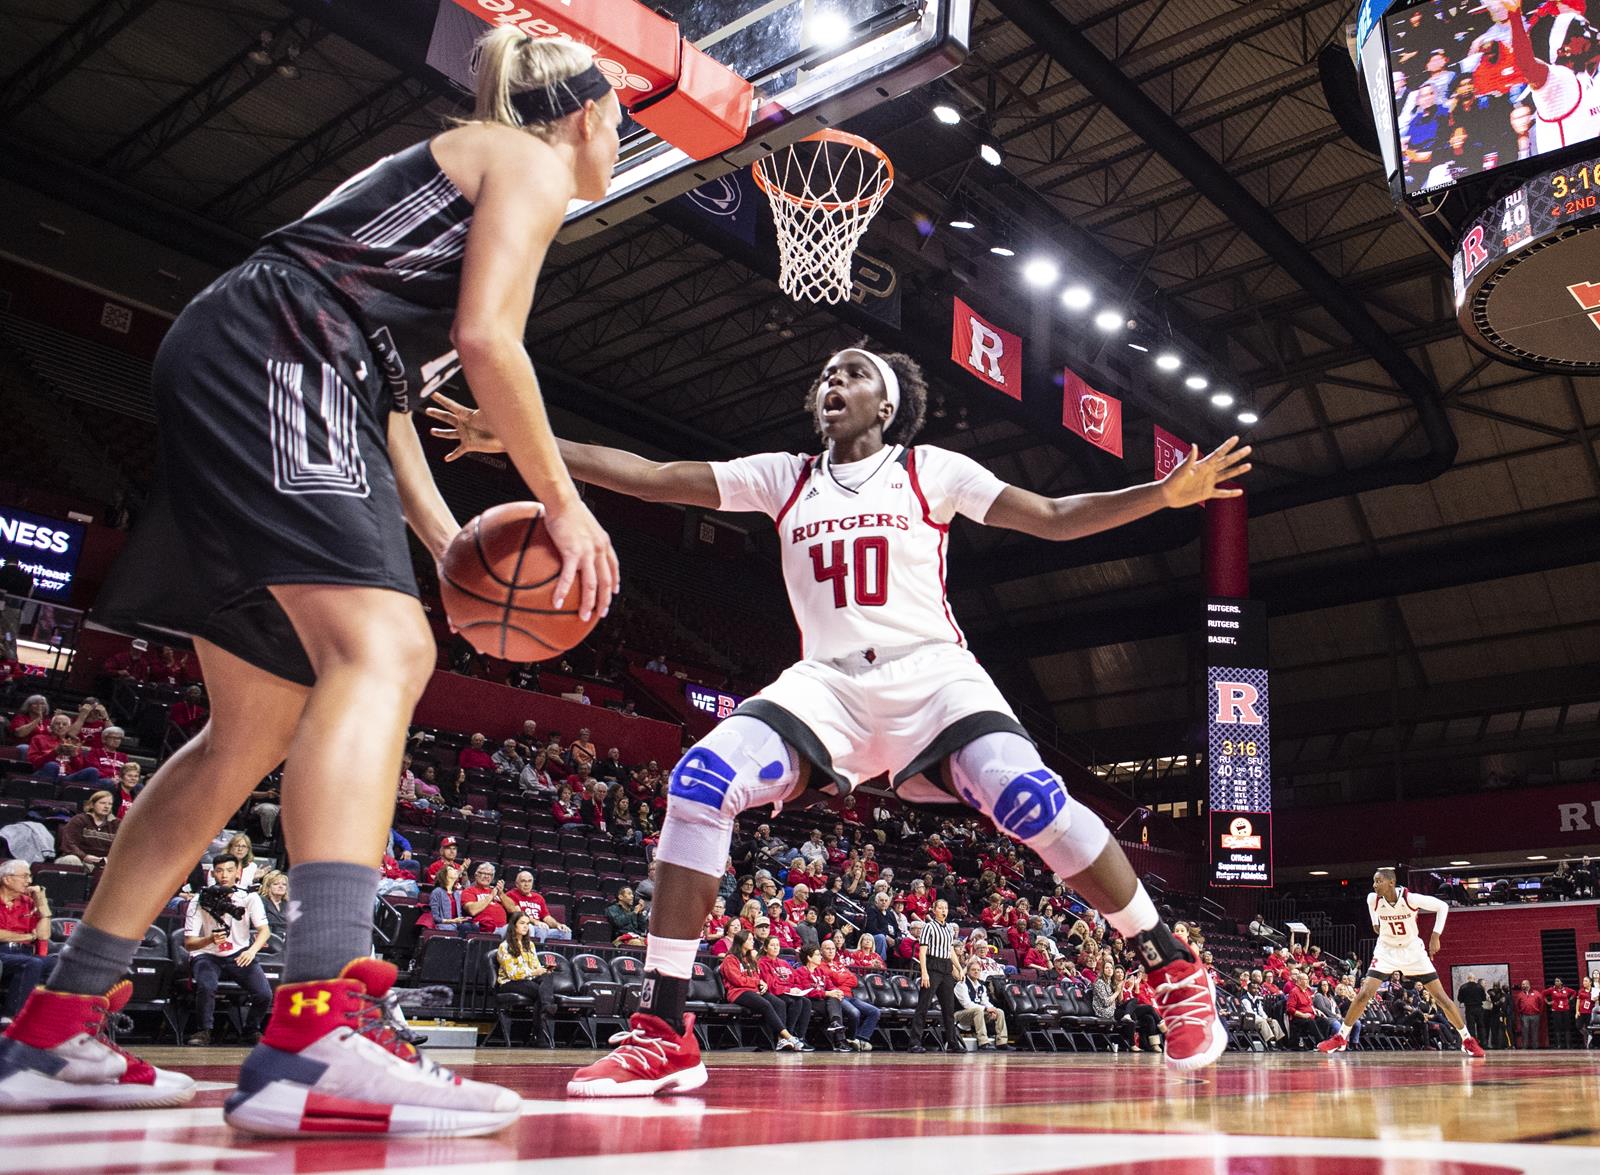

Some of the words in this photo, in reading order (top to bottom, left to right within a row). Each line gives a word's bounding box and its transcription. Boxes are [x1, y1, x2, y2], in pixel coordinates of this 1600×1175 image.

[1411, 180, 1458, 197] DAKTRONICS
[1552, 163, 1600, 199] 3:16
[1505, 190, 1522, 209] RU
[1565, 195, 1597, 215] 2ND
[1501, 204, 1526, 231] 40
[1463, 225, 1488, 279] R
[968, 315, 1004, 384] R
[0, 516, 70, 553] NESS
[792, 513, 909, 544] RUTGERS
[808, 535, 889, 609] 40
[1207, 620, 1239, 628] RUTGERS
[691, 691, 716, 712] WE
[1215, 681, 1262, 725] R
[1222, 740, 1257, 756] 3:16
[1219, 756, 1231, 764] RU
[1247, 757, 1263, 765] SFU
[1217, 765, 1233, 777] 40
[1248, 766, 1262, 778] 15
[1388, 921, 1406, 935] 13
